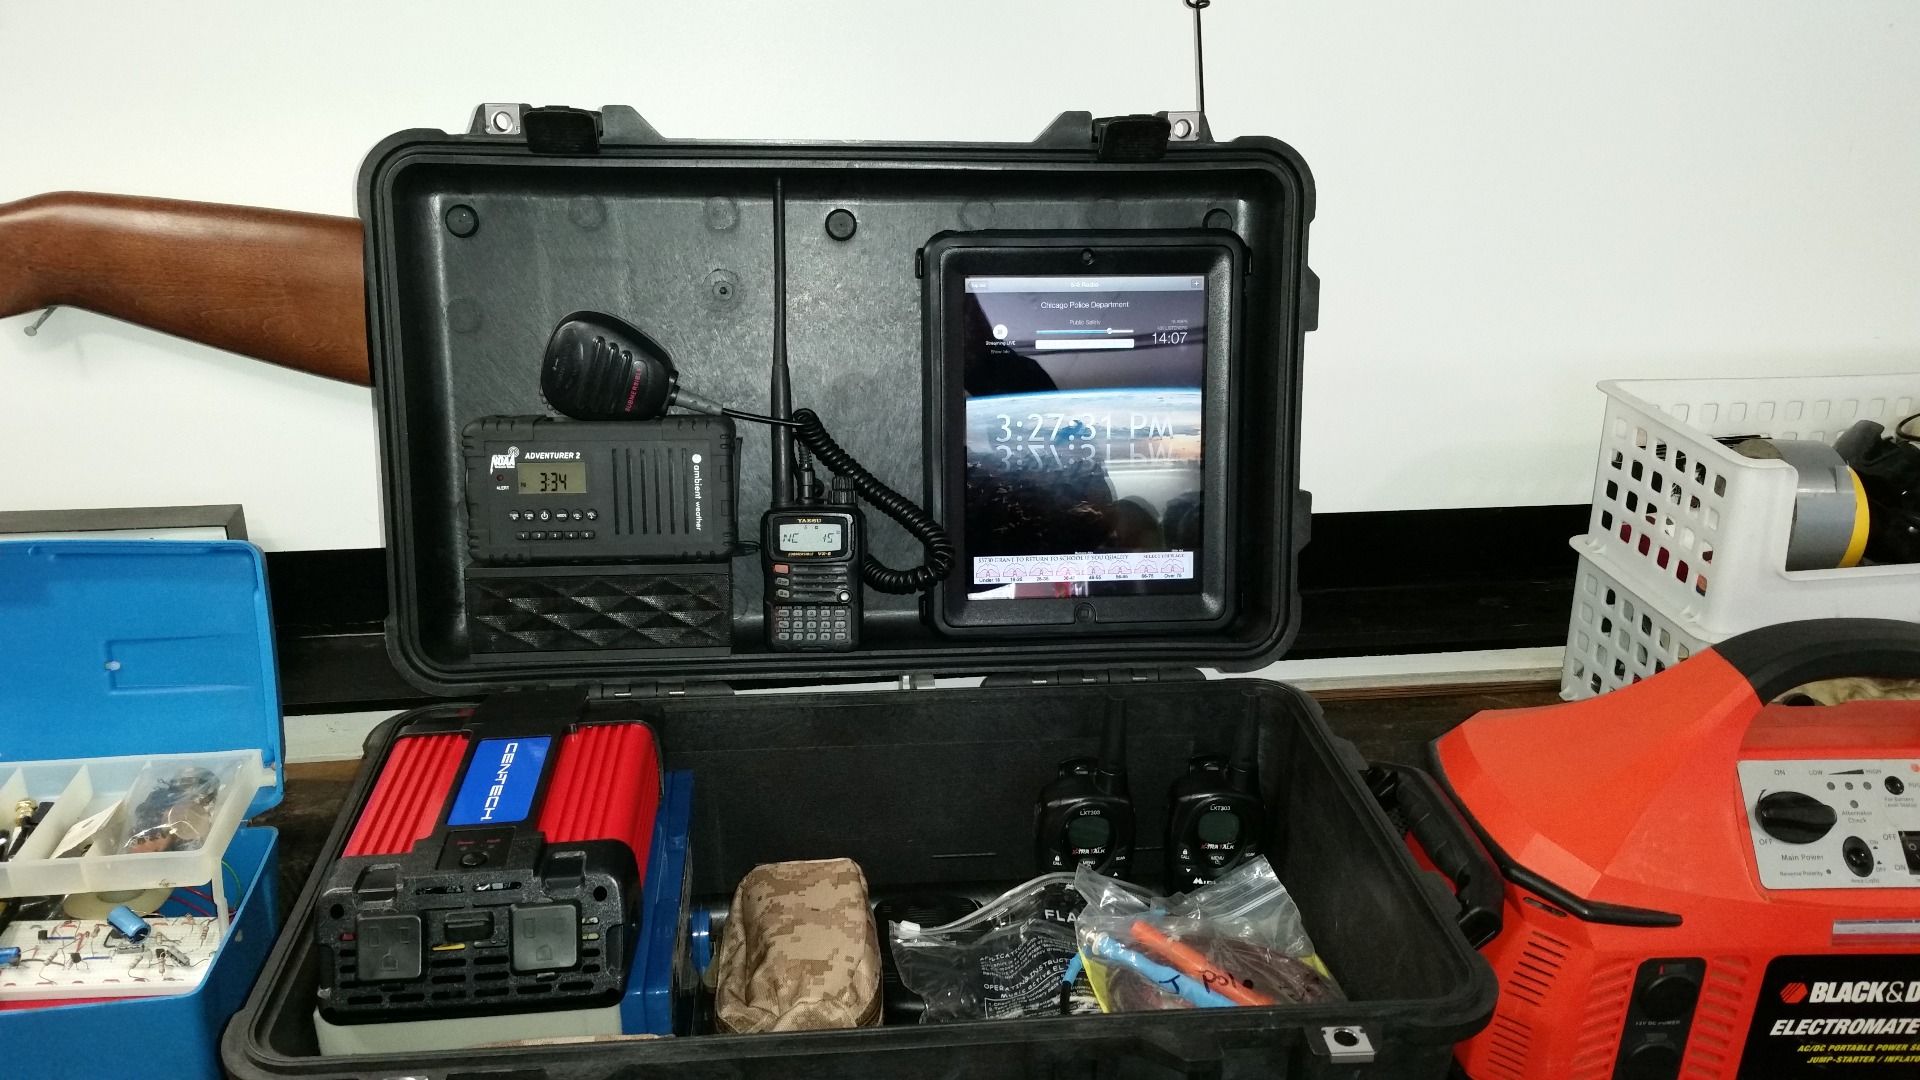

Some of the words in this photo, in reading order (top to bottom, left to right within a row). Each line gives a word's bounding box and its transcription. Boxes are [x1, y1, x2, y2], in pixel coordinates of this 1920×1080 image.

[1040, 301, 1068, 310] Chicago
[1069, 301, 1089, 309] Police
[1090, 301, 1129, 309] Department
[1151, 331, 1188, 345] 14:07
[625, 368, 642, 412] SUBMERSIBLE
[996, 413, 1112, 443] 3:27:31
[1130, 413, 1174, 440] PM
[525, 452, 574, 460] ADVENTURER
[540, 472, 567, 492] 3:34
[693, 464, 702, 500] ambient
[1044, 909, 1078, 923] FLA
[980, 942, 1025, 962] APPLICATIO
[983, 976, 1030, 992] OPERATING
[1029, 957, 1069, 979] INSTRUCT
[1808, 981, 1920, 1003] BLACK&D
[1769, 1018, 1920, 1036] ELECTROMATE
[1797, 1044, 1826, 1052] AC/DC
[1827, 1044, 1874, 1052] PORTABLE
[1875, 1043, 1909, 1051] POWER
[1806, 1055, 1876, 1064] JUMP-STARTER
[1884, 1055, 1920, 1063] INFLATO
